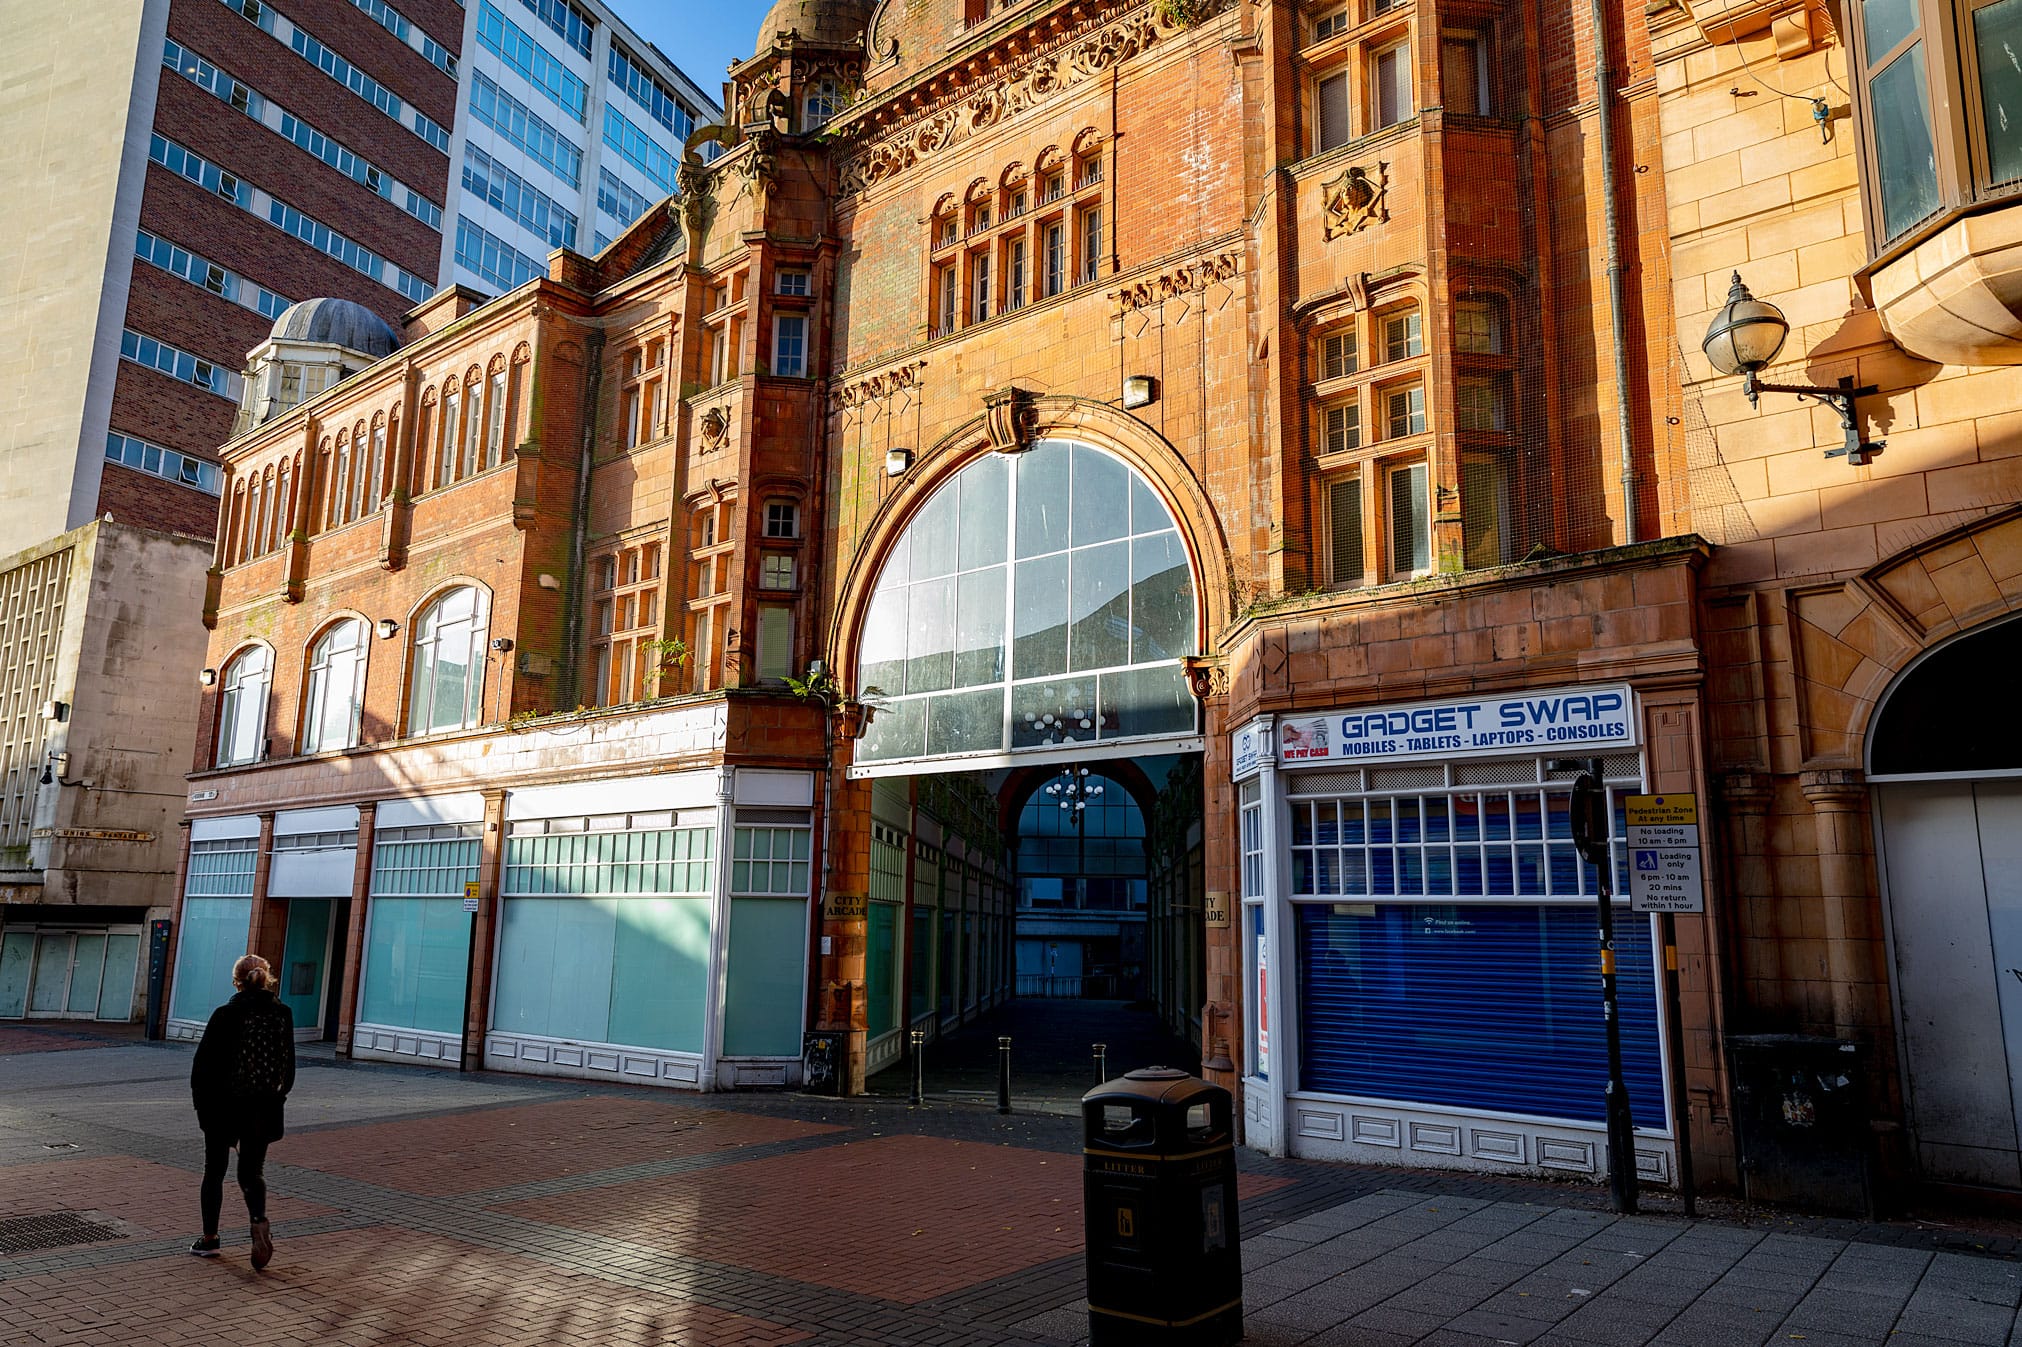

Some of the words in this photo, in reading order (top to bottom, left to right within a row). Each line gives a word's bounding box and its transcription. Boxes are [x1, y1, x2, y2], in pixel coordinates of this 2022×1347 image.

[1341, 705, 1481, 739] GADGET
[1499, 693, 1622, 728] SWAP
[1342, 739, 1396, 756] MOBILES
[1406, 735, 1461, 751] TABLETS
[1472, 729, 1535, 747] LAPTOPS
[1546, 722, 1625, 741] CONSOLES
[1284, 750, 1295, 759] WE
[1296, 749, 1309, 759] PAY
[1310, 747, 1329, 758] CASH
[1628, 807, 1671, 815] Pedestrian
[1673, 806, 1693, 814] Zone
[1654, 827, 1684, 836] loading
[1674, 838, 1687, 846] pm
[1660, 852, 1692, 861] Loading
[1666, 861, 1685, 869] only
[1666, 873, 1676, 881] 10
[834, 895, 862, 906] CITY
[1205, 897, 1216, 908] TY
[826, 906, 866, 916] ARCADE
[1205, 910, 1225, 922] ADE
[1104, 1160, 1146, 1174] LITTER
